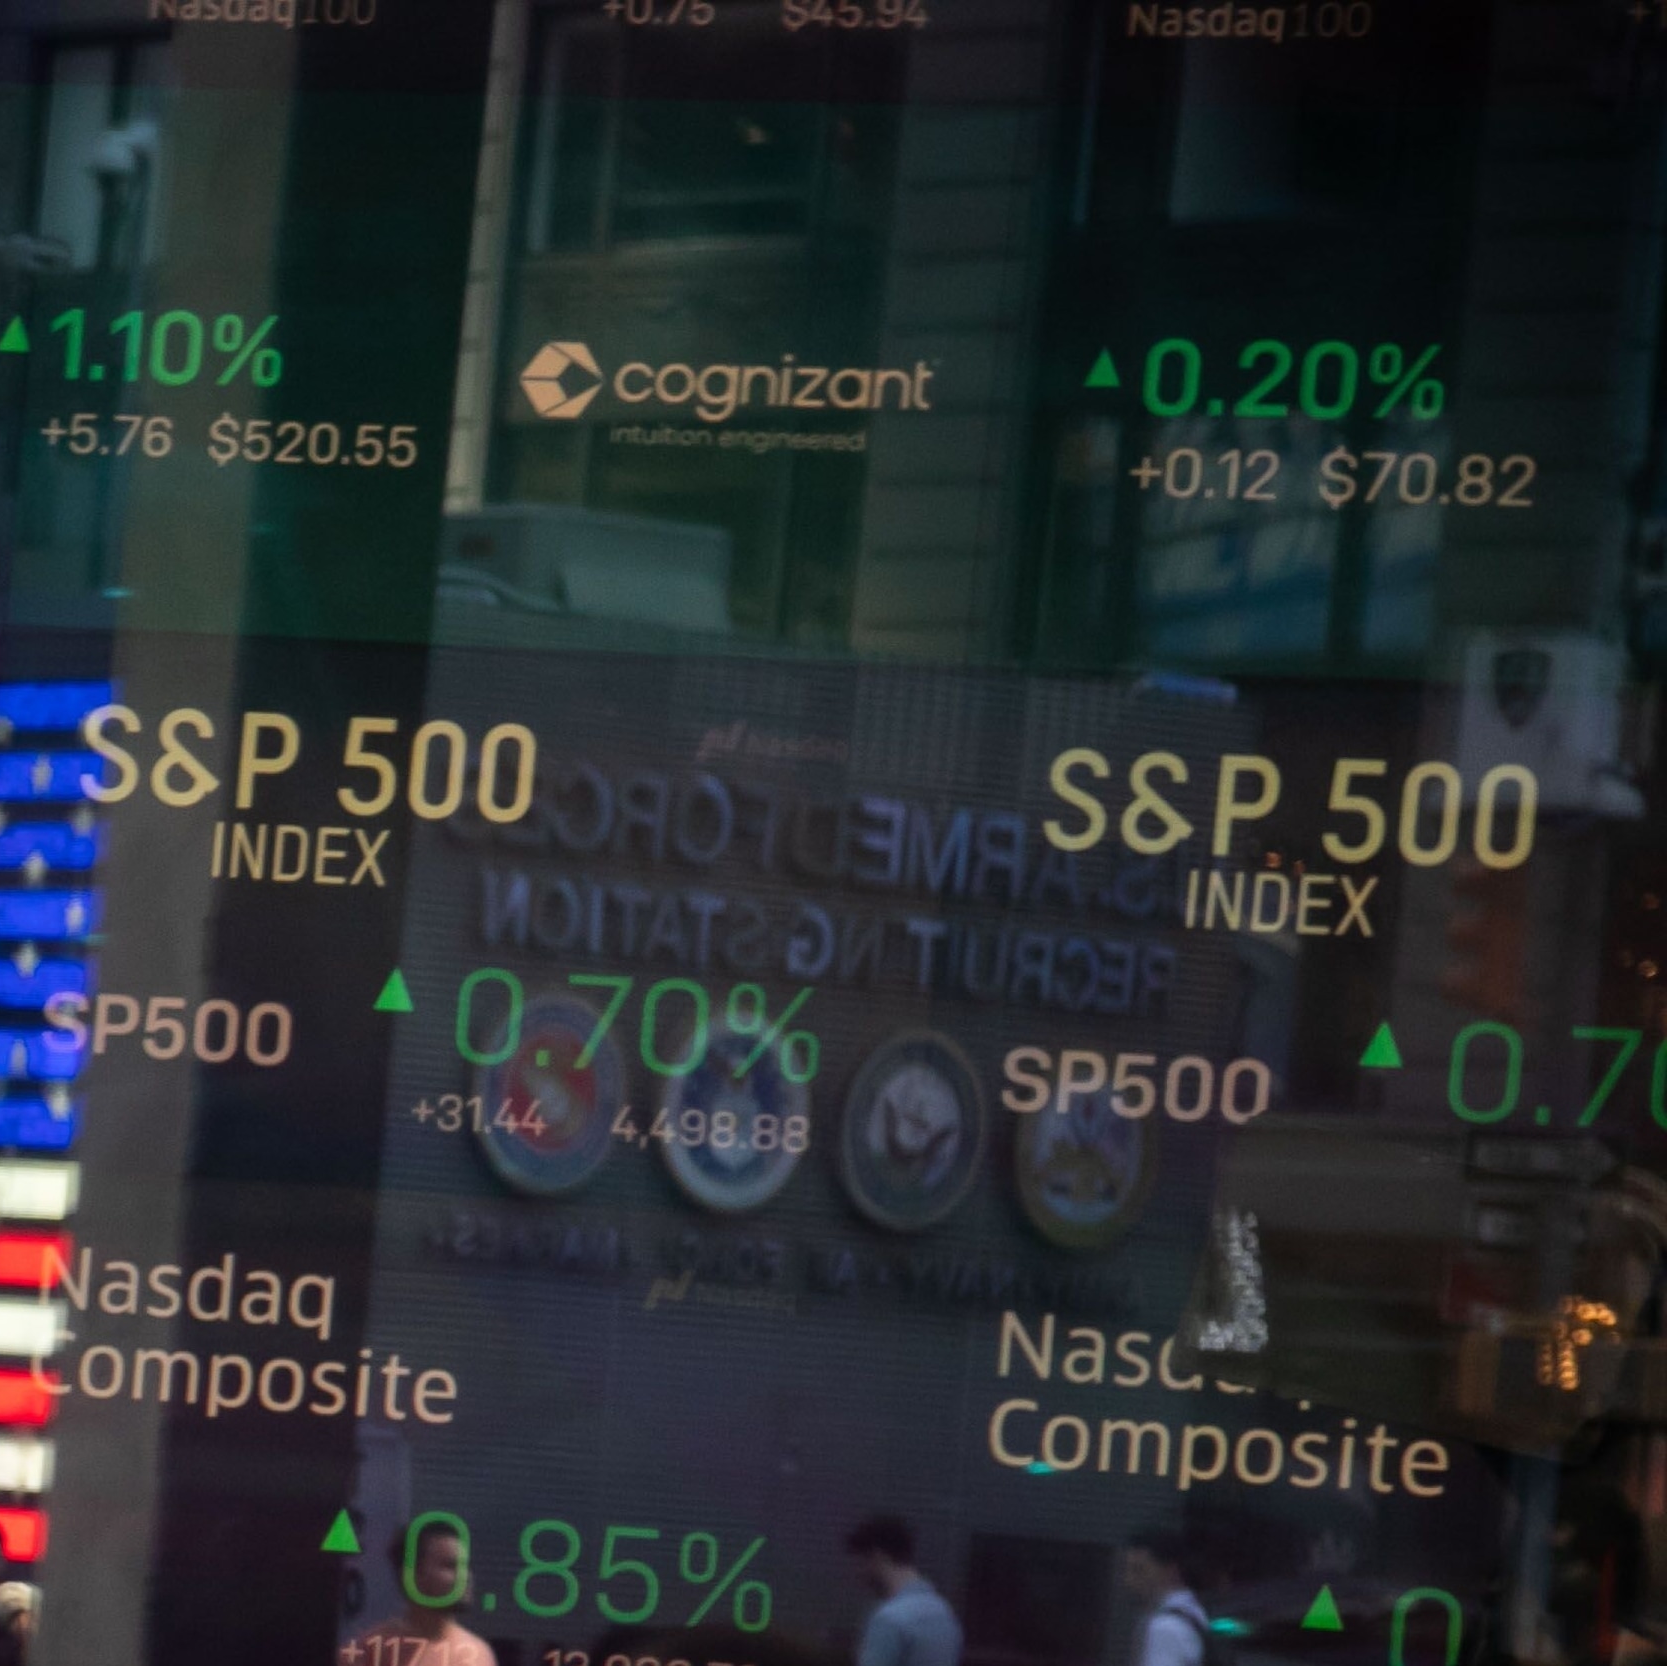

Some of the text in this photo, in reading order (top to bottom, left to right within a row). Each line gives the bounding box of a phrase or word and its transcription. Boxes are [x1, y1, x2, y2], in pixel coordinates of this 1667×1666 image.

[48, 307, 284, 388] 1.10%
[612, 354, 933, 422] cognizant
[1142, 338, 1446, 422] 0.20%
[40, 411, 419, 469] +5.76 $520.55
[1127, 444, 1538, 510] +0.12 $70.82
[79, 703, 538, 826] S&P 500
[1042, 746, 1540, 872] S&P 500
[209, 820, 391, 888] INDEX
[1184, 867, 1381, 939] INDEX
[41, 989, 294, 1068] SP500
[455, 966, 821, 1086] 0.70%
[1000, 1045, 1273, 1126] SP500
[1448, 1020, 1667, 1129] 0.7
[410, 1091, 812, 1155] +31.44 4,498.88
[37, 1246, 336, 1342] Nasdaq
[31, 1329, 458, 1425] Composite
[988, 1397, 1452, 1499] Composite
[402, 1510, 774, 1634] 0.85%
